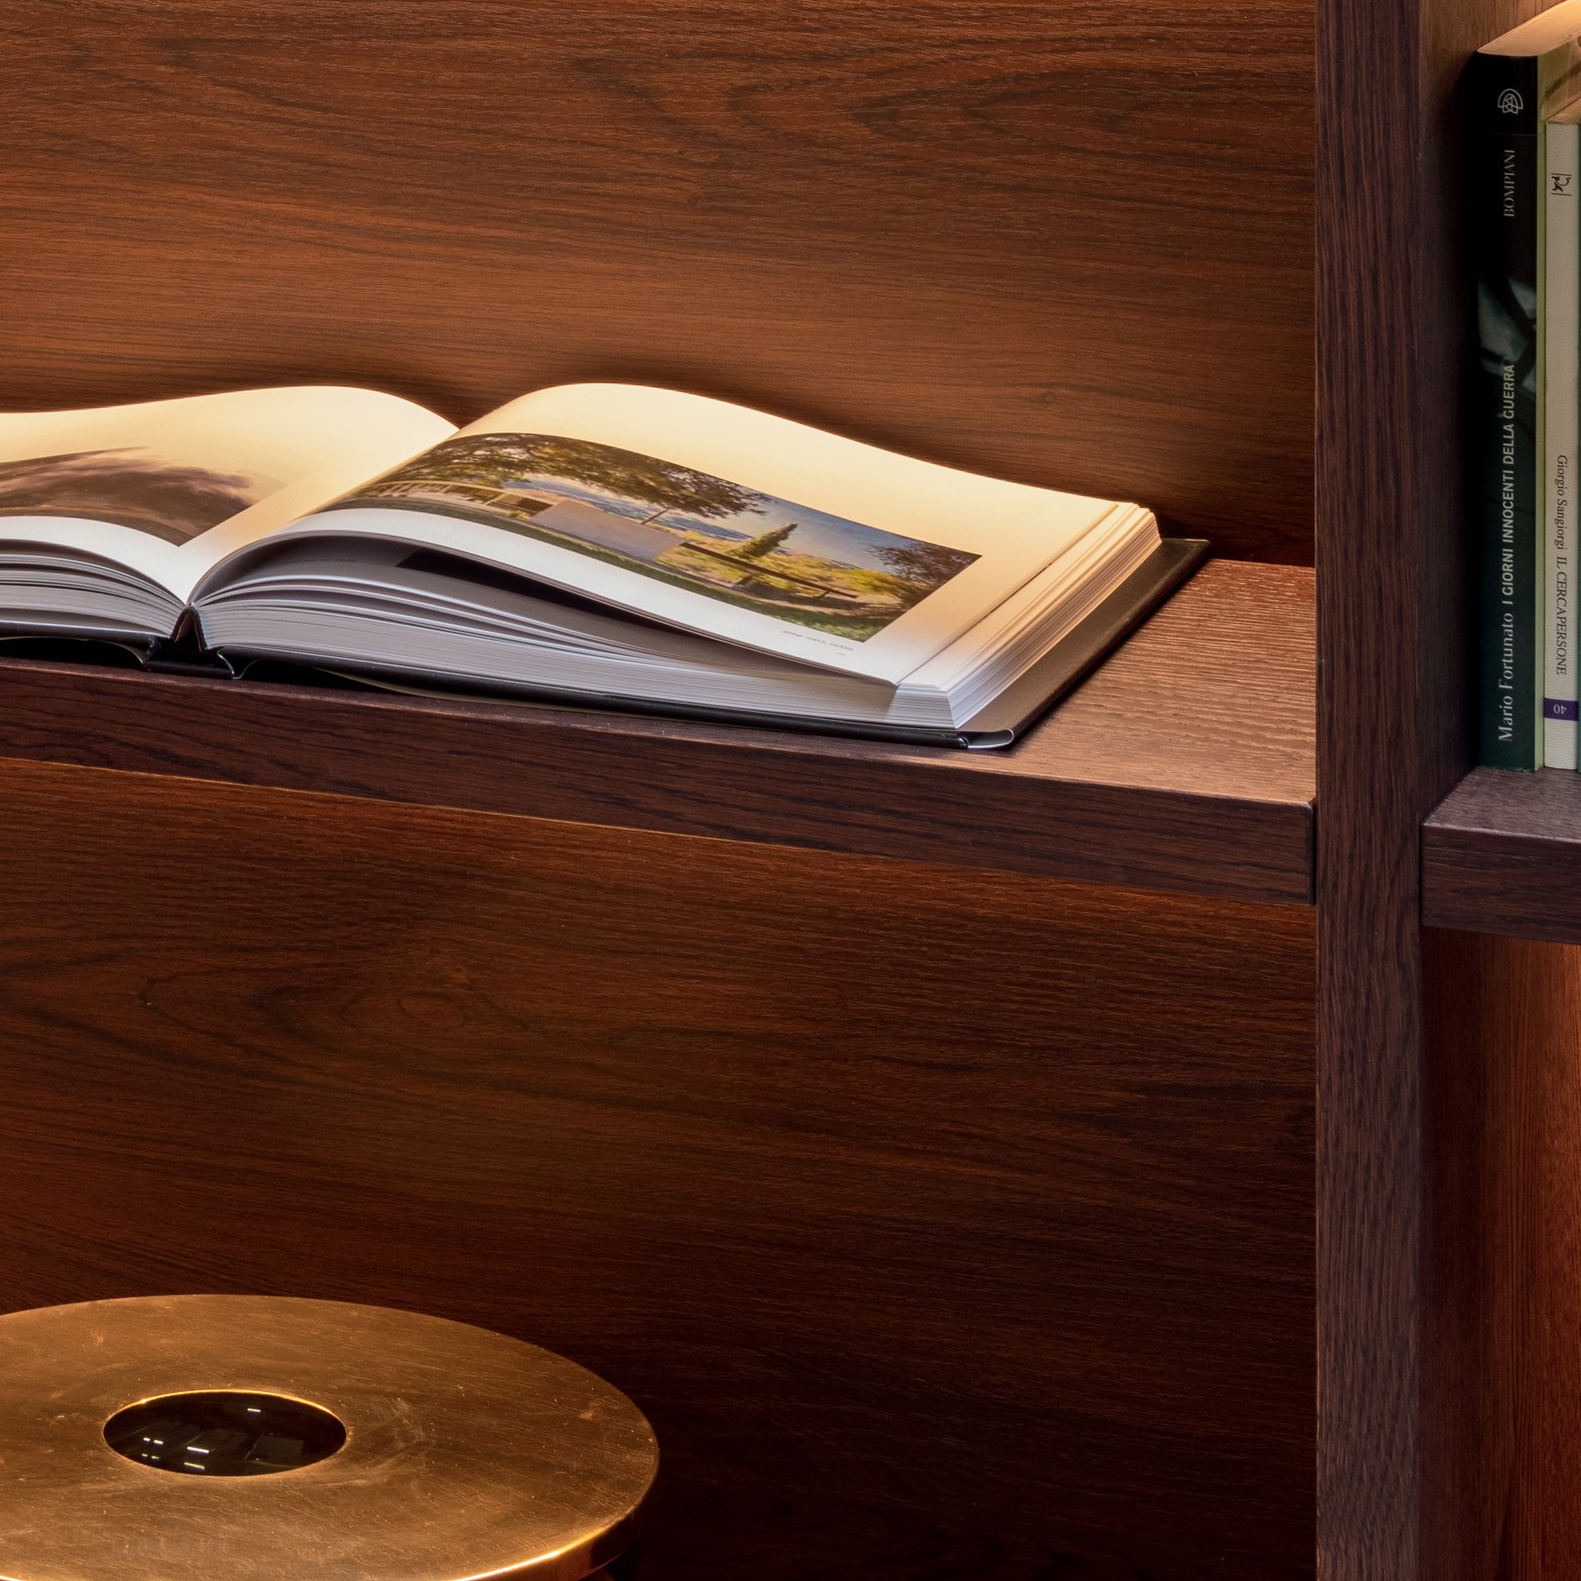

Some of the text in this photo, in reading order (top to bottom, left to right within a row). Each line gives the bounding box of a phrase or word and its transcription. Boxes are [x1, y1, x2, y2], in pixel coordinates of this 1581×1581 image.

[1503, 149, 1515, 217] BOMPIANI
[1503, 364, 1515, 419] GUERRA
[1503, 424, 1515, 465] DELLA
[1502, 470, 1514, 543] INNOCENTI
[1502, 549, 1514, 595] GIORNI
[1555, 455, 1568, 676] Giorgio Sangiorgi IL CERCAPERSONE
[1499, 613, 1514, 689] Fortunato
[1498, 696, 1514, 742] Mario
[1554, 704, 1567, 714] 40
